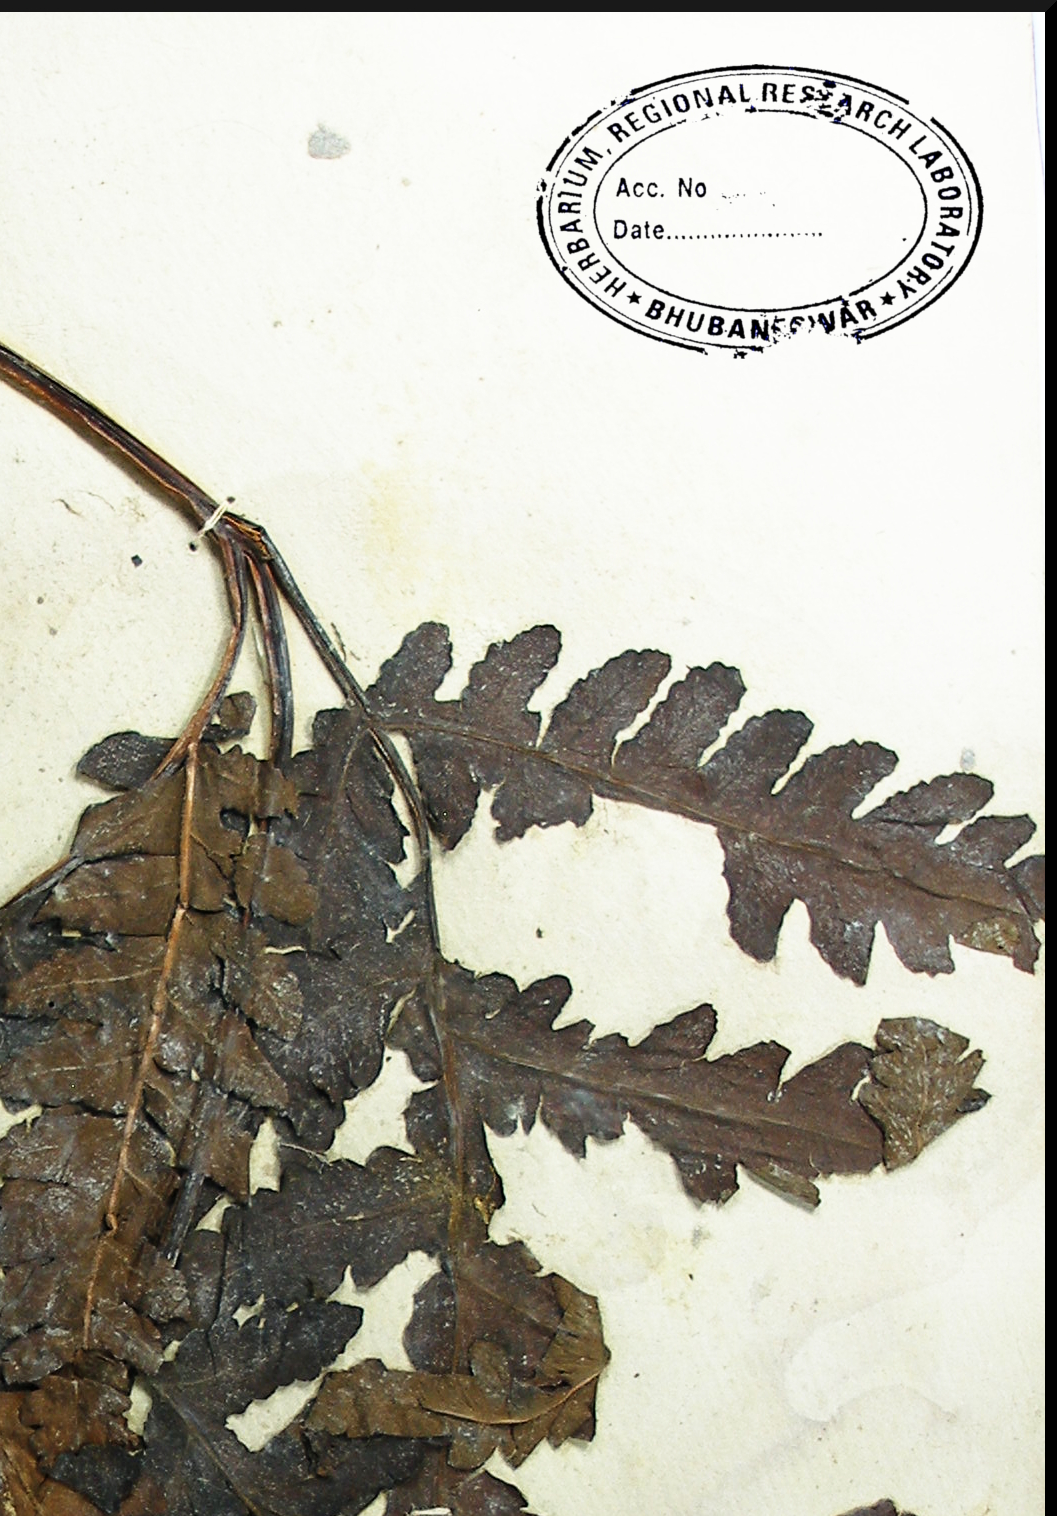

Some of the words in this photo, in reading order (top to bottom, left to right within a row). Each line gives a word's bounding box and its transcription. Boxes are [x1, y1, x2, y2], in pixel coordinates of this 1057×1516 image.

[607, 83, 751, 144] REGIONAL
[908, 134, 964, 300] LABORATORY
[616, 177, 665, 198] Acc.
[678, 177, 707, 198] No
